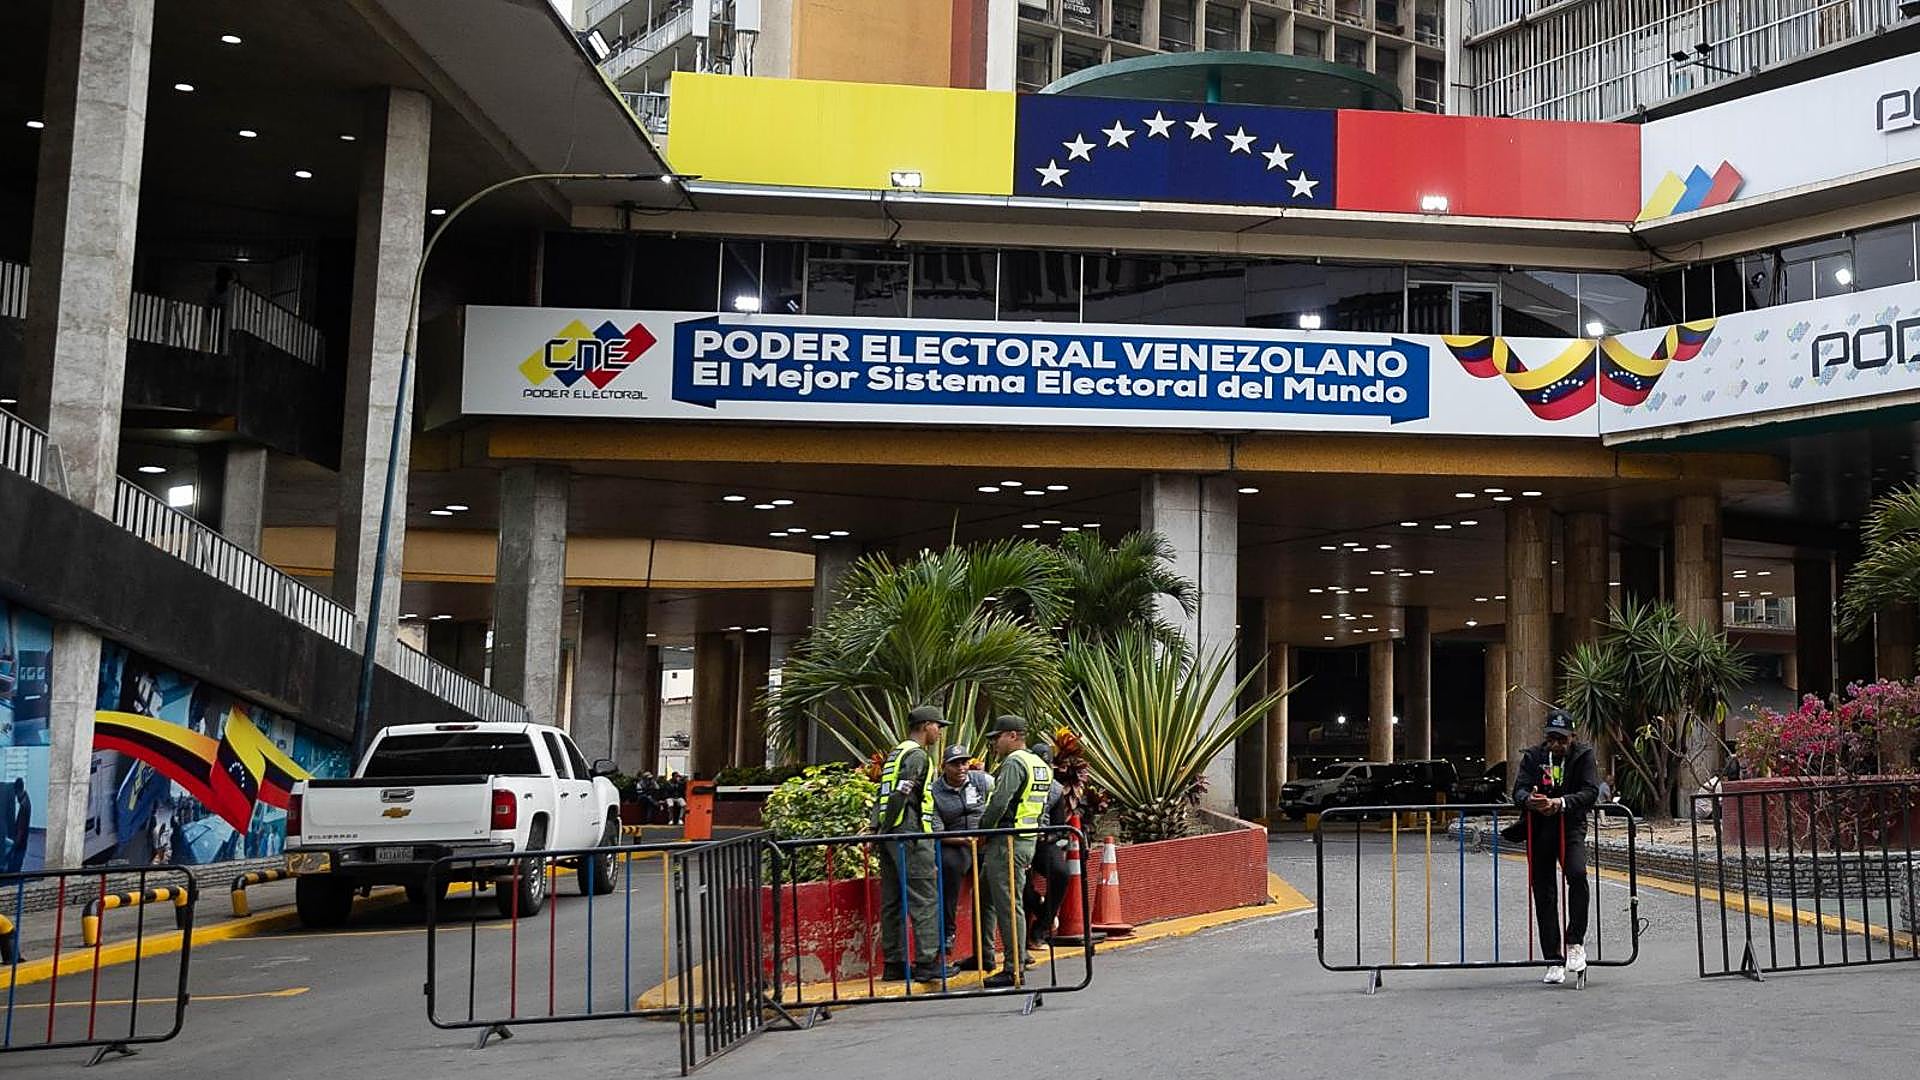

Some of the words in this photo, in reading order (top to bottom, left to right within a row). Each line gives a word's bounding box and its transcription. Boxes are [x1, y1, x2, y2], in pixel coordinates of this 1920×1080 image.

[1877, 86, 1920, 130] P
[544, 338, 632, 369] CNE
[693, 329, 850, 362] PODER
[861, 334, 1117, 370] ELECTORAL
[1122, 342, 1408, 378] VENEZOLANO
[523, 388, 570, 398] PODER
[573, 389, 649, 400] ELECTORAL
[692, 361, 730, 386] El
[742, 362, 860, 396] Mejor
[867, 365, 1026, 394] Sistema
[1036, 370, 1207, 398] Electoral
[1217, 374, 1273, 400] del
[1283, 376, 1408, 404] Mundo
